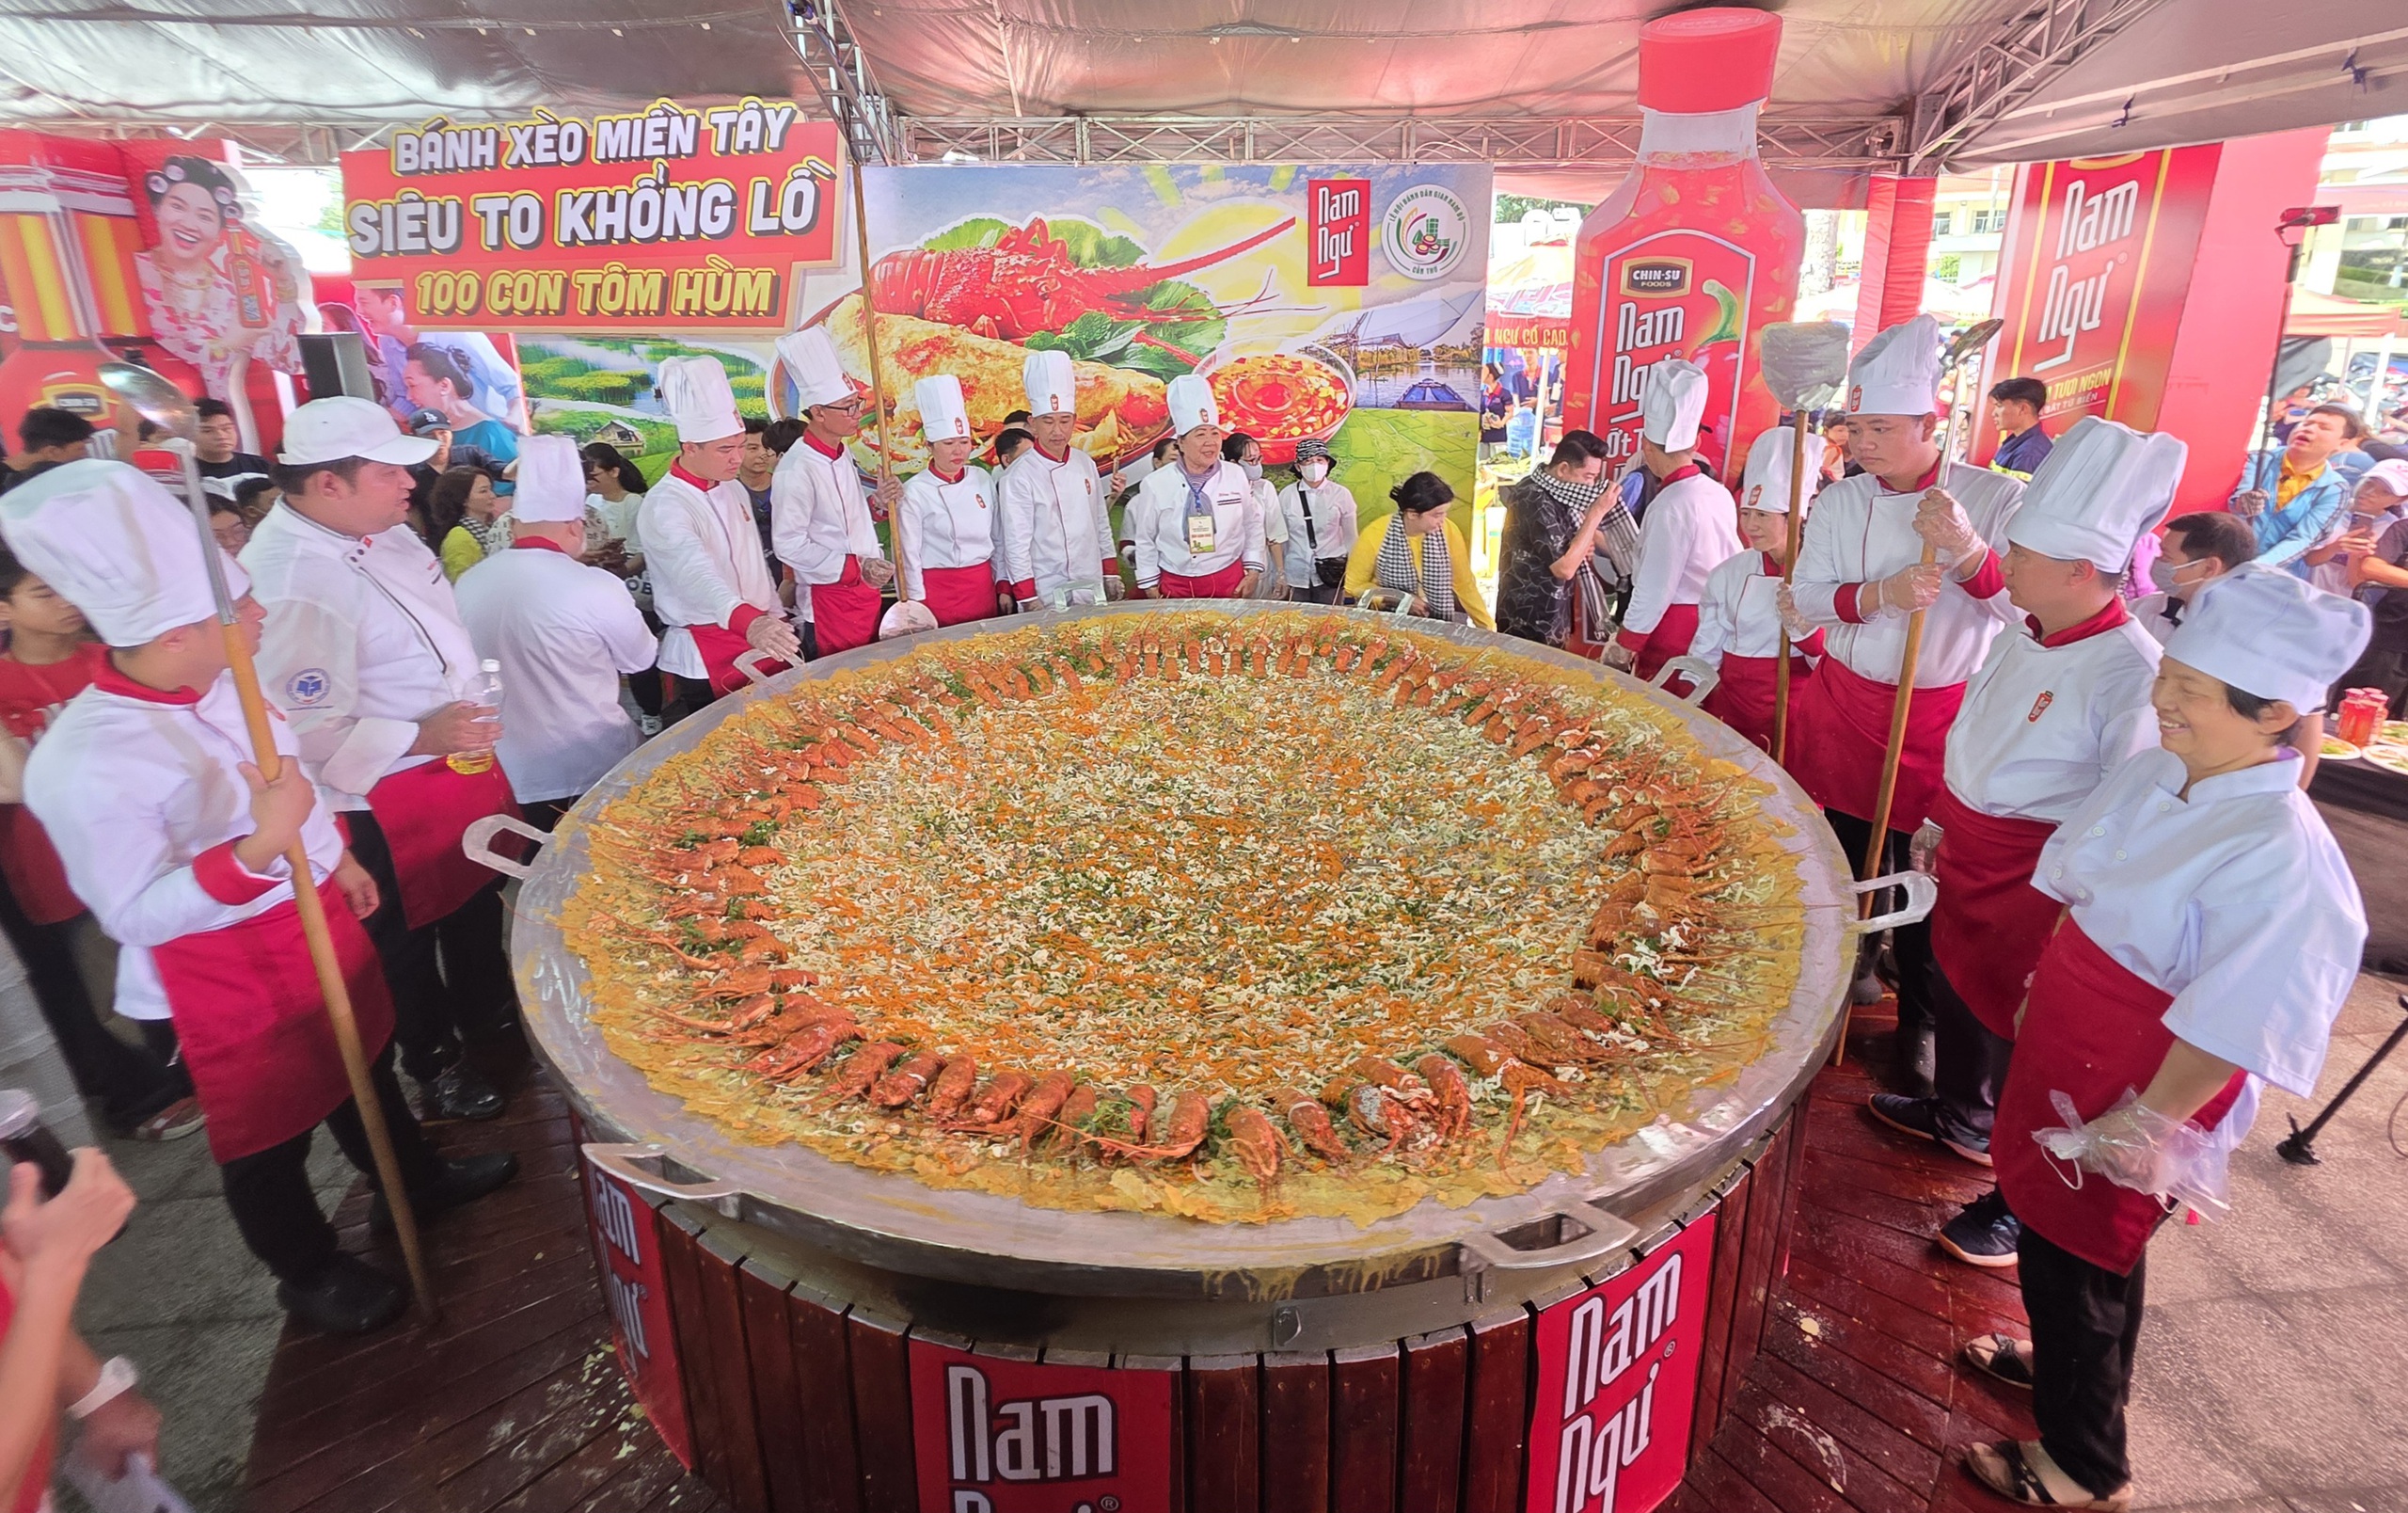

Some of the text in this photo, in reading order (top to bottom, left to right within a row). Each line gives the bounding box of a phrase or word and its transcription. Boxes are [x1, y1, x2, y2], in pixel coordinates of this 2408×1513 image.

[394, 100, 796, 173] BÁNH XÈO MIỀN TÂY
[349, 159, 837, 257] SIÊU TO KHỔNG LỒ
[1318, 185, 1360, 227] Nam
[2055, 179, 2139, 261] Nam
[417, 257, 779, 315] 100 CON TÔM HÙM
[1632, 269, 1681, 281] CHIN-SU
[1615, 301, 1685, 353] Nam
[1610, 354, 1671, 423] Ng
[1564, 1253, 1682, 1420] Nam
[948, 1364, 1115, 1482] Nam
